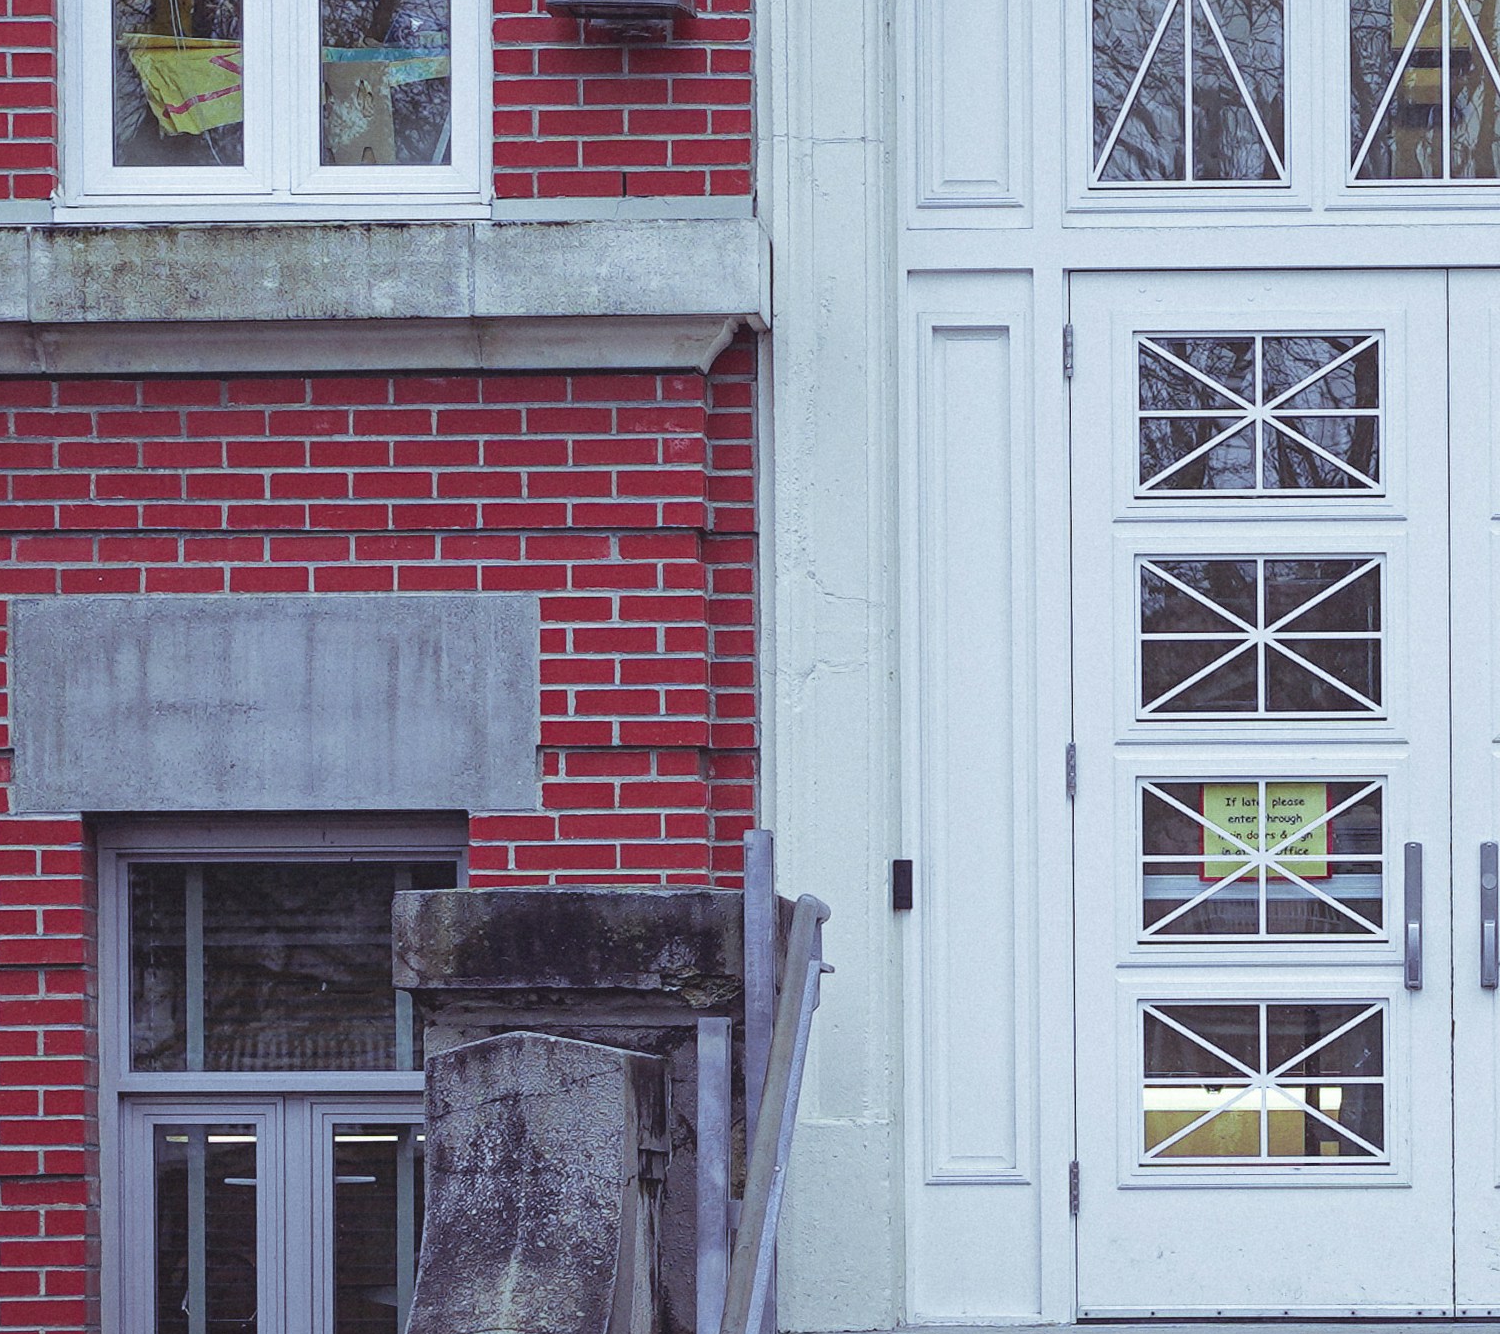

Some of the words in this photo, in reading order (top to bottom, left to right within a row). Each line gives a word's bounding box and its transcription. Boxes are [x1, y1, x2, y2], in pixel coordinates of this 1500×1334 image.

[1224, 797, 1236, 807] If
[1271, 797, 1305, 809] please
[1228, 814, 1257, 824] enter
[1266, 813, 1303, 826] hrough
[1246, 830, 1276, 840] dors
[1280, 830, 1288, 840] &
[1221, 847, 1231, 855] in
